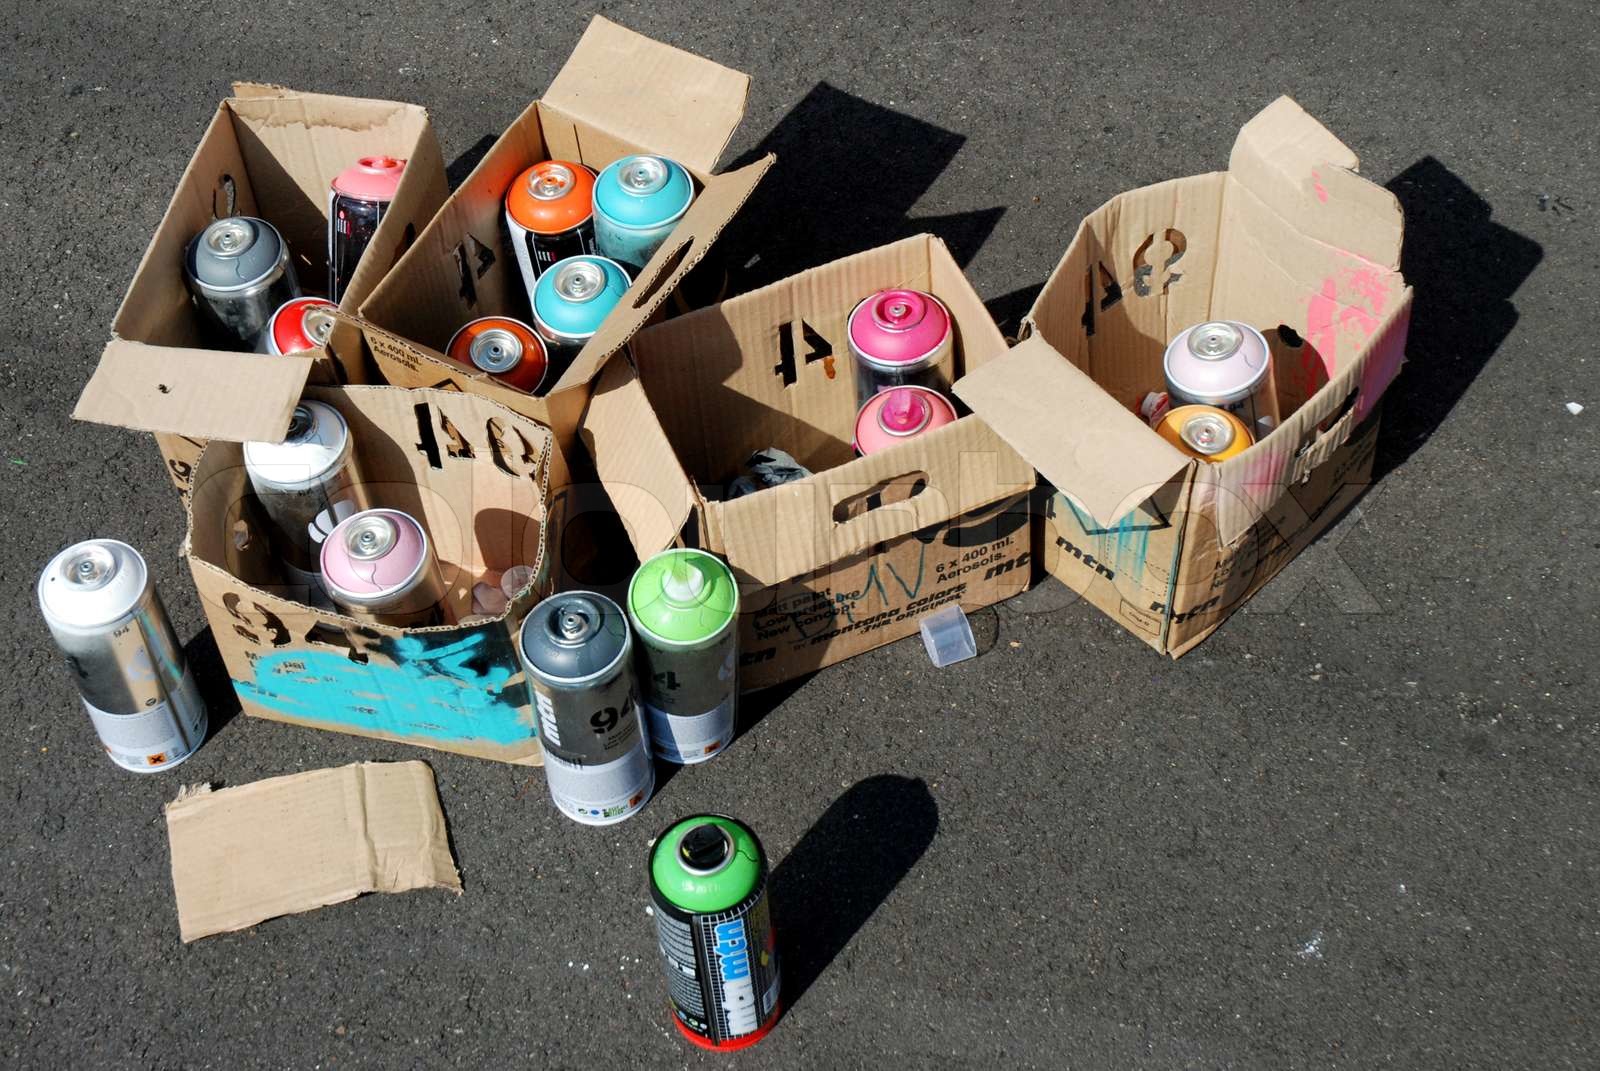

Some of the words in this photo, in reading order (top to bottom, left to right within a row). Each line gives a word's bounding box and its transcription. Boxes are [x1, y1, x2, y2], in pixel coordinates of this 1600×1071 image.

[387, 344, 405, 357] 400
[935, 563, 945, 573] 6
[948, 559, 958, 569] x
[961, 546, 988, 562] 400
[992, 536, 1015, 551] ml.
[936, 552, 1007, 584] Aerosols.
[983, 551, 1031, 581] mt
[1055, 536, 1115, 581] mtn
[810, 608, 901, 645] montana
[906, 584, 966, 611] colors
[738, 647, 777, 667] tn
